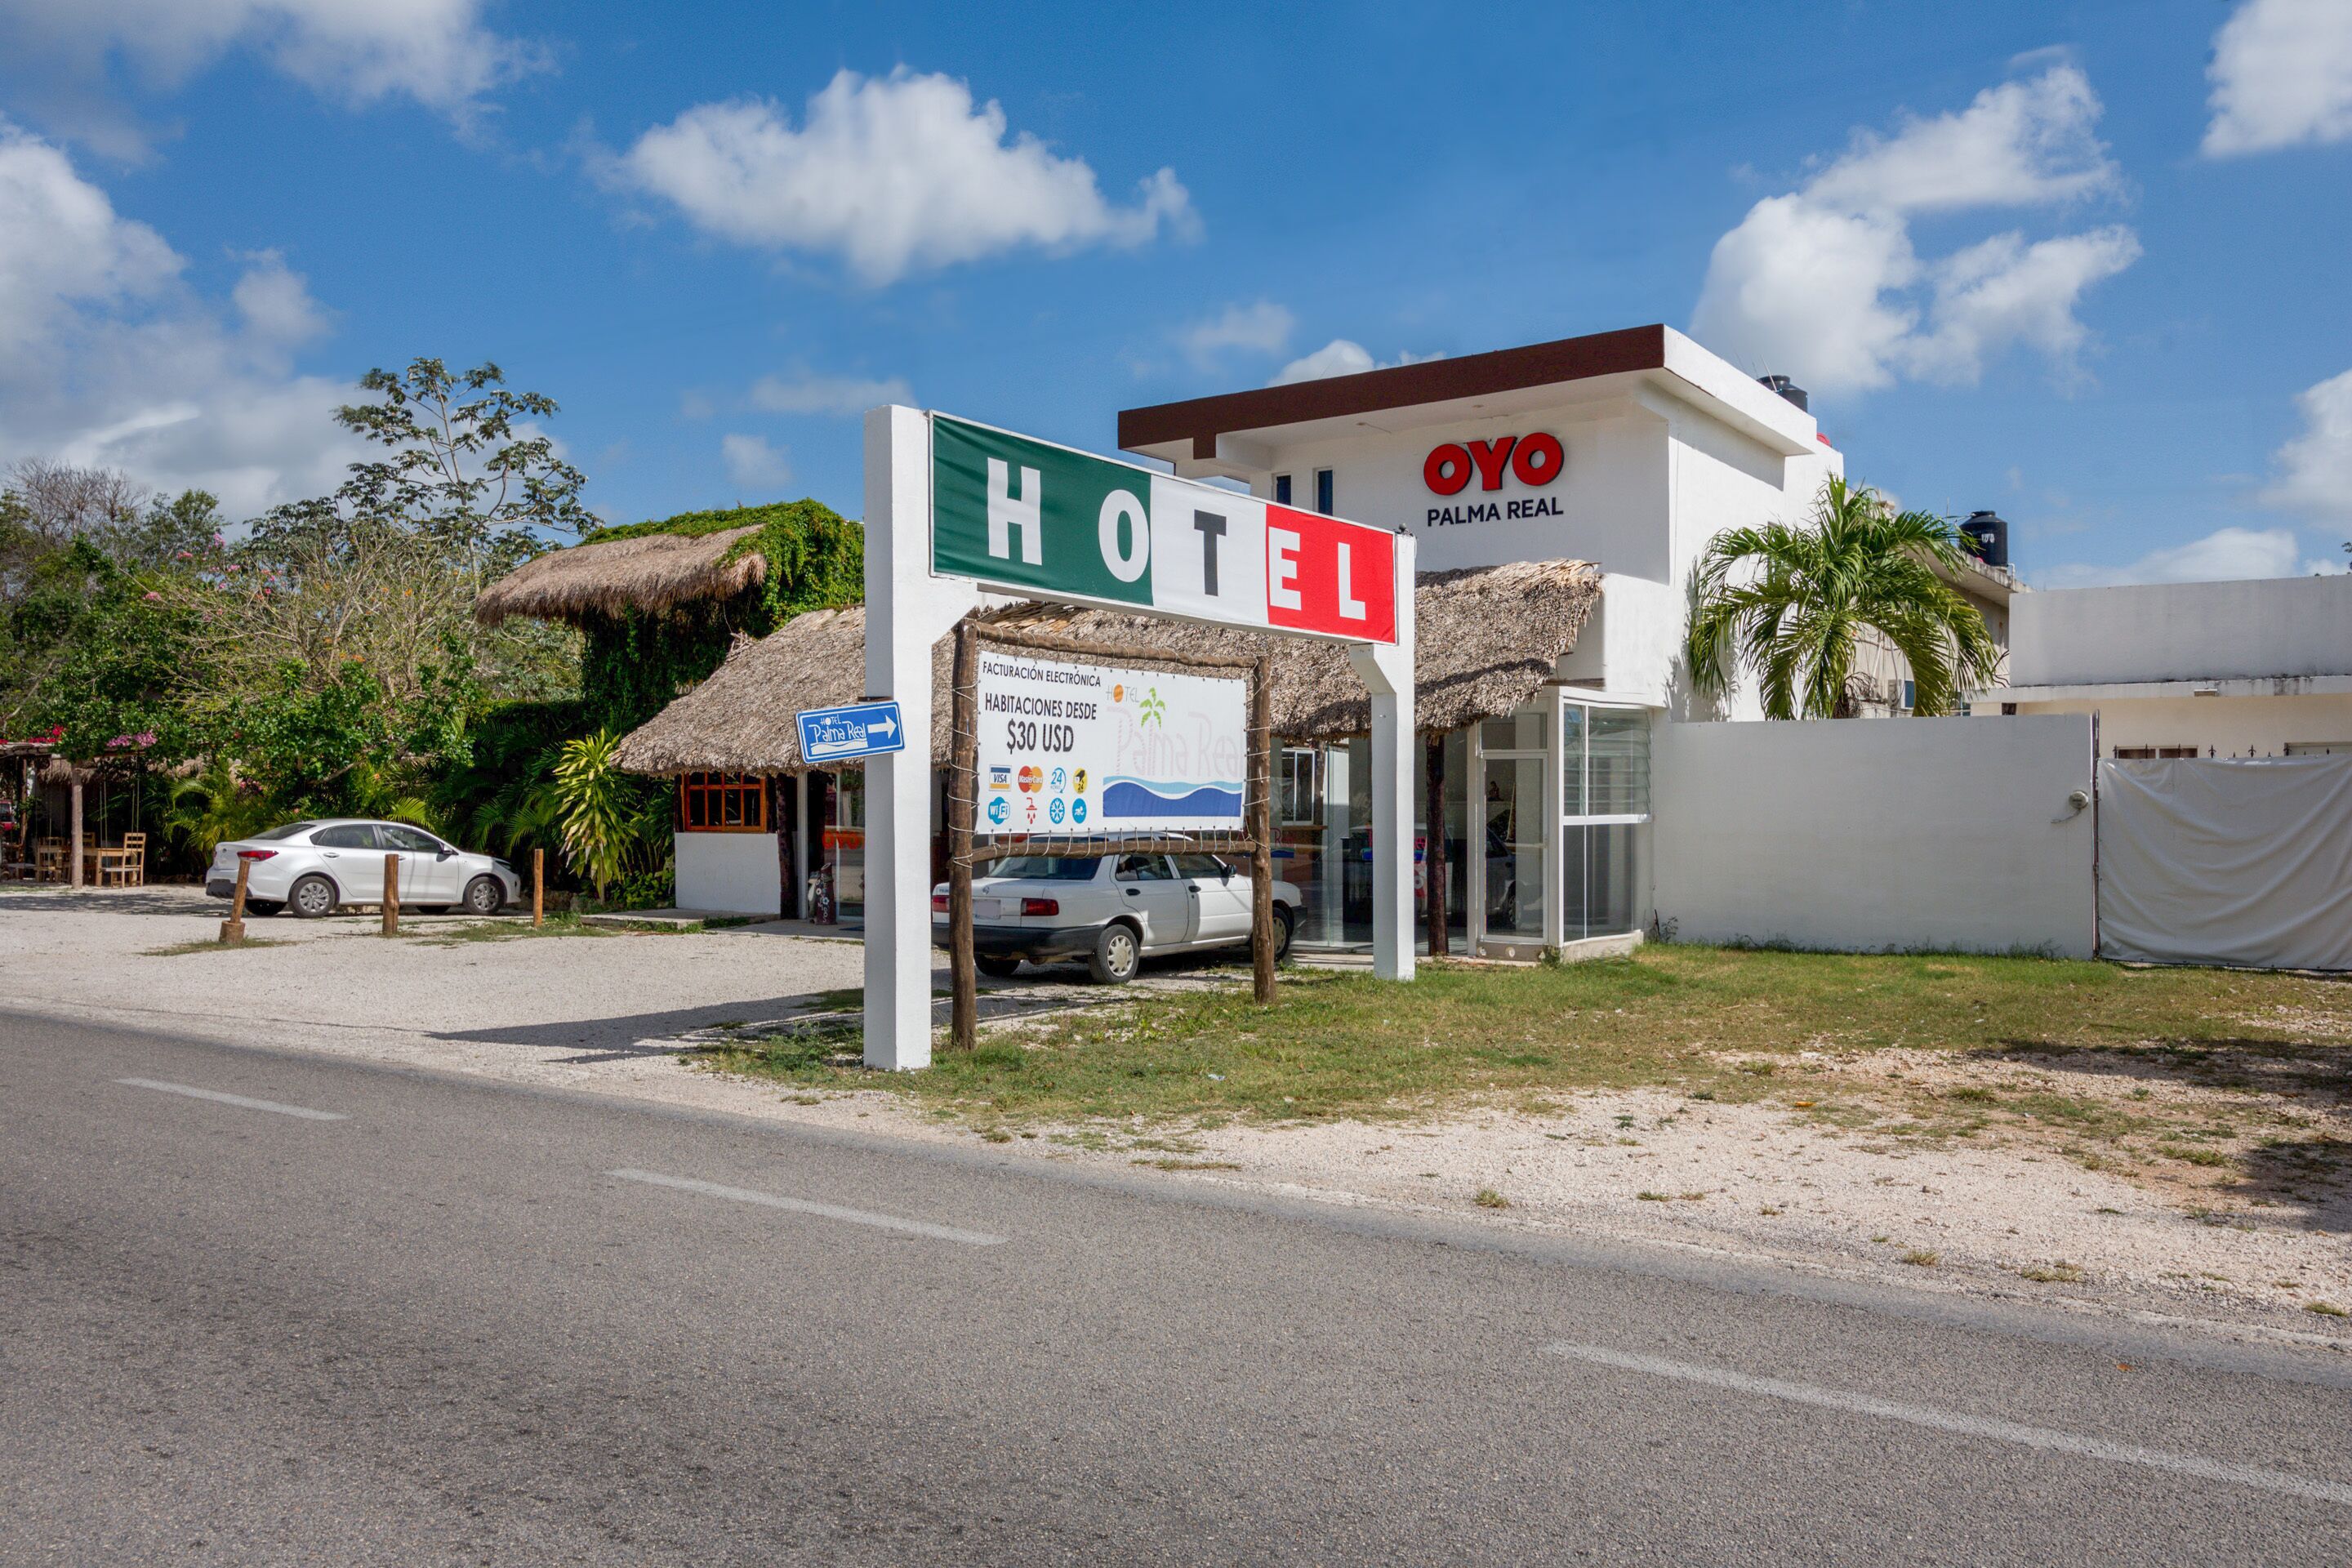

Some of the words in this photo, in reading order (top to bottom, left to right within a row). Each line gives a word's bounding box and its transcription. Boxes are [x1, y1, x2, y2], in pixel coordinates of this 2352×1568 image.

[1423, 432, 1564, 496] OYO
[1428, 503, 1500, 527] PALMA
[1508, 497, 1564, 519] REAL
[987, 457, 1365, 620] HOTEL
[982, 661, 1043, 681] FACTURACIÓN
[1046, 670, 1101, 687] ELECTRÓNICA
[985, 693, 1062, 717] HABITACIONES
[1066, 702, 1097, 719] DESDE
[1106, 684, 1140, 703] HOTEL
[808, 720, 845, 743] Palma
[842, 721, 866, 740] Real
[820, 715, 842, 726] HOTEL
[1006, 719, 1036, 754] $30
[1042, 724, 1074, 752] USD
[1106, 706, 1189, 777] Palma
[993, 773, 1008, 783] VISA
[1050, 772, 1062, 785] 24
